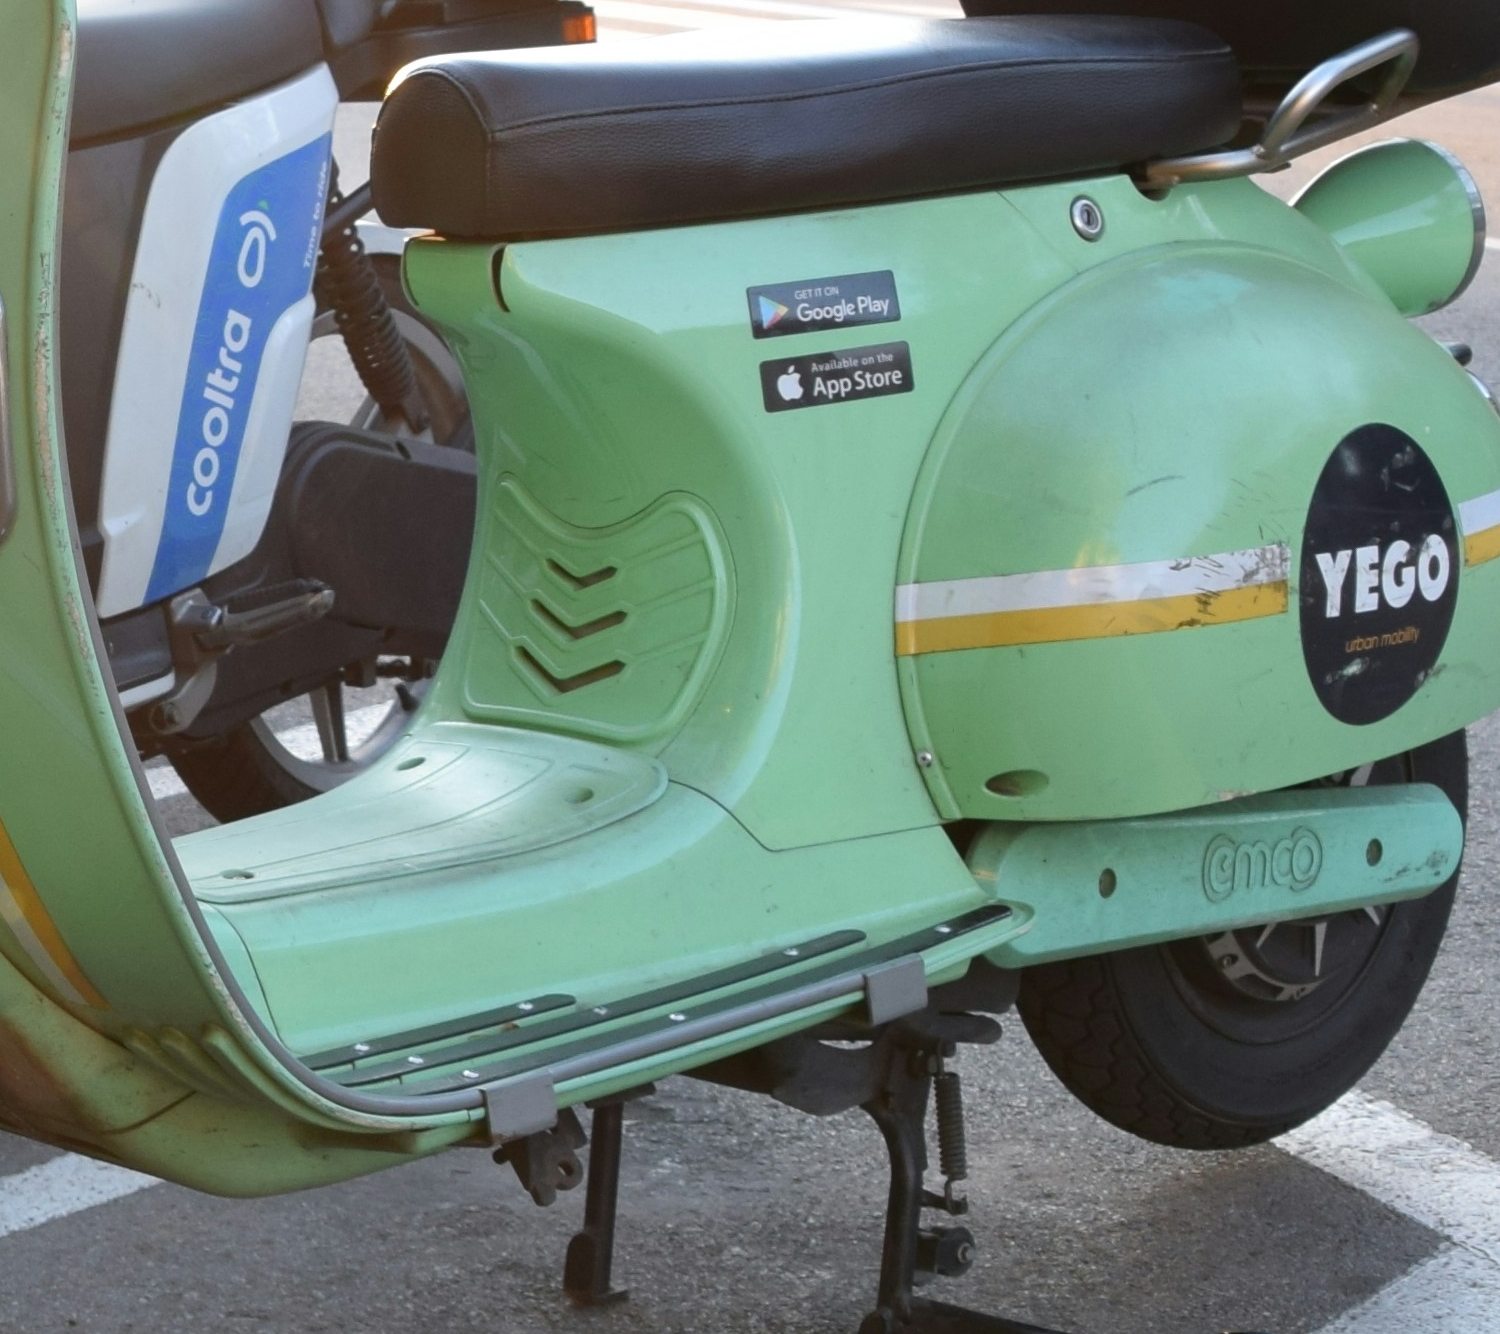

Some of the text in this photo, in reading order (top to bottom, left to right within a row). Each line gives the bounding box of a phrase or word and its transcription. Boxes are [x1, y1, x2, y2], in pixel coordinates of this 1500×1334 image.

[794, 285, 840, 300] GET IT ON
[796, 296, 890, 323] Google Play
[811, 352, 894, 373] Available on the
[813, 369, 903, 399] App Store
[186, 307, 253, 516] cooltra
[1314, 533, 1450, 619] YEGO
[1345, 626, 1420, 653] urban mobility
